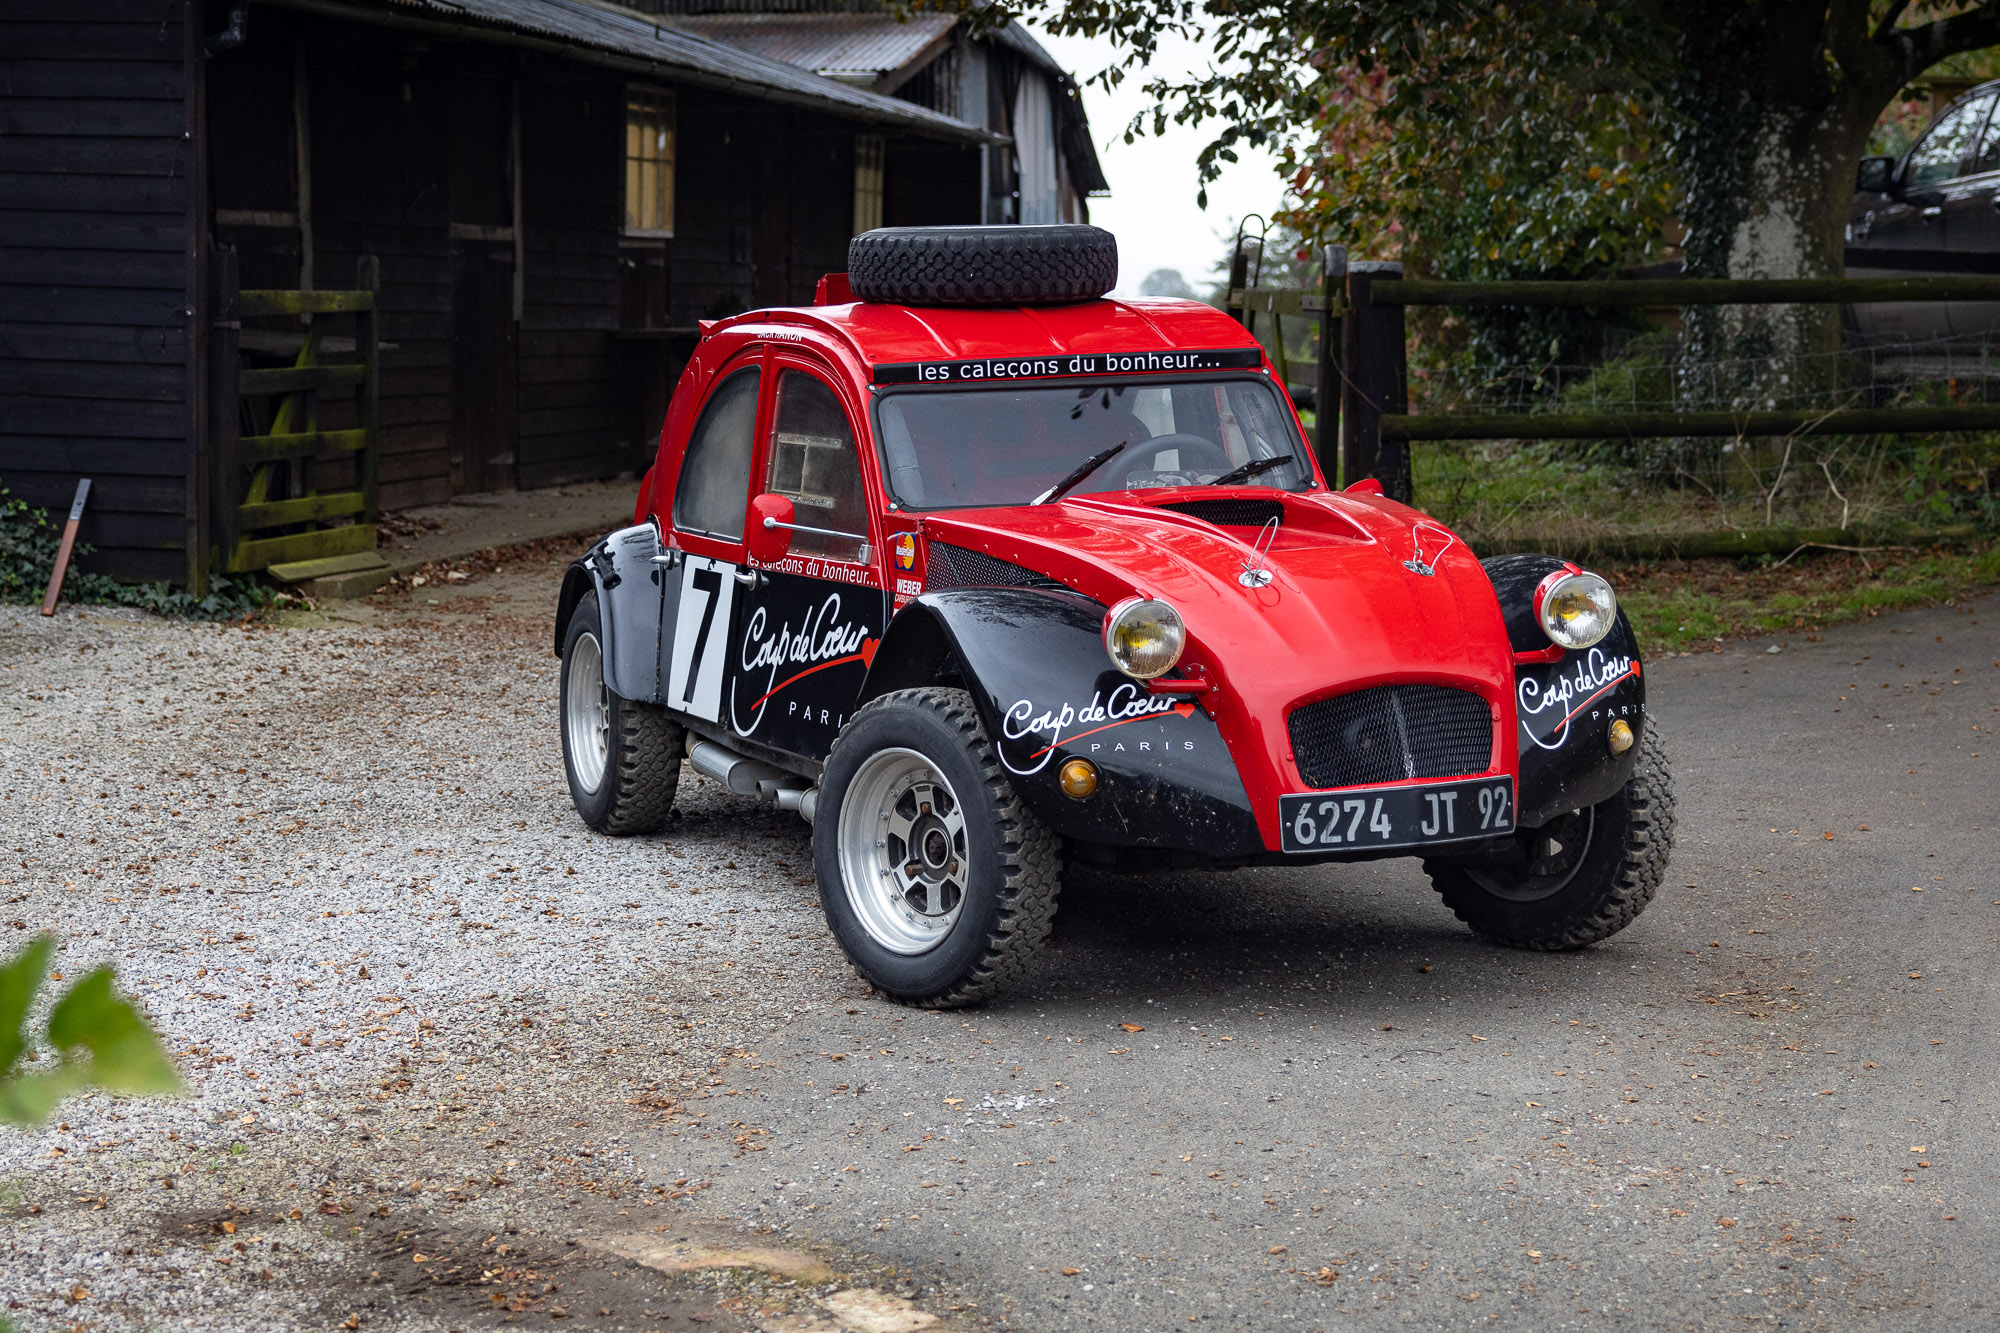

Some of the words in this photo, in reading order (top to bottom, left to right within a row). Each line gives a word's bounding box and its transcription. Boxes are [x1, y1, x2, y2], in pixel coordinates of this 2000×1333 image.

[917, 363, 950, 381] les
[959, 358, 1059, 378] caleçons
[1069, 355, 1096, 374] du
[1106, 352, 1221, 371] bonheur...
[806, 558, 819, 577] du
[822, 560, 878, 587] bonheur...
[896, 579, 922, 595] WEBER
[683, 568, 722, 704] 7
[790, 605, 812, 663] de
[789, 701, 843, 729] PARI
[1519, 675, 1573, 750] Coup
[1575, 660, 1594, 692] de
[1592, 703, 1646, 721] PARIS
[997, 699, 1075, 775] Coup
[1078, 690, 1105, 723] de
[1091, 741, 1194, 753] PARIS
[1294, 798, 1392, 845] 6274
[1421, 791, 1457, 836] JT
[1478, 786, 1509, 830] 92
